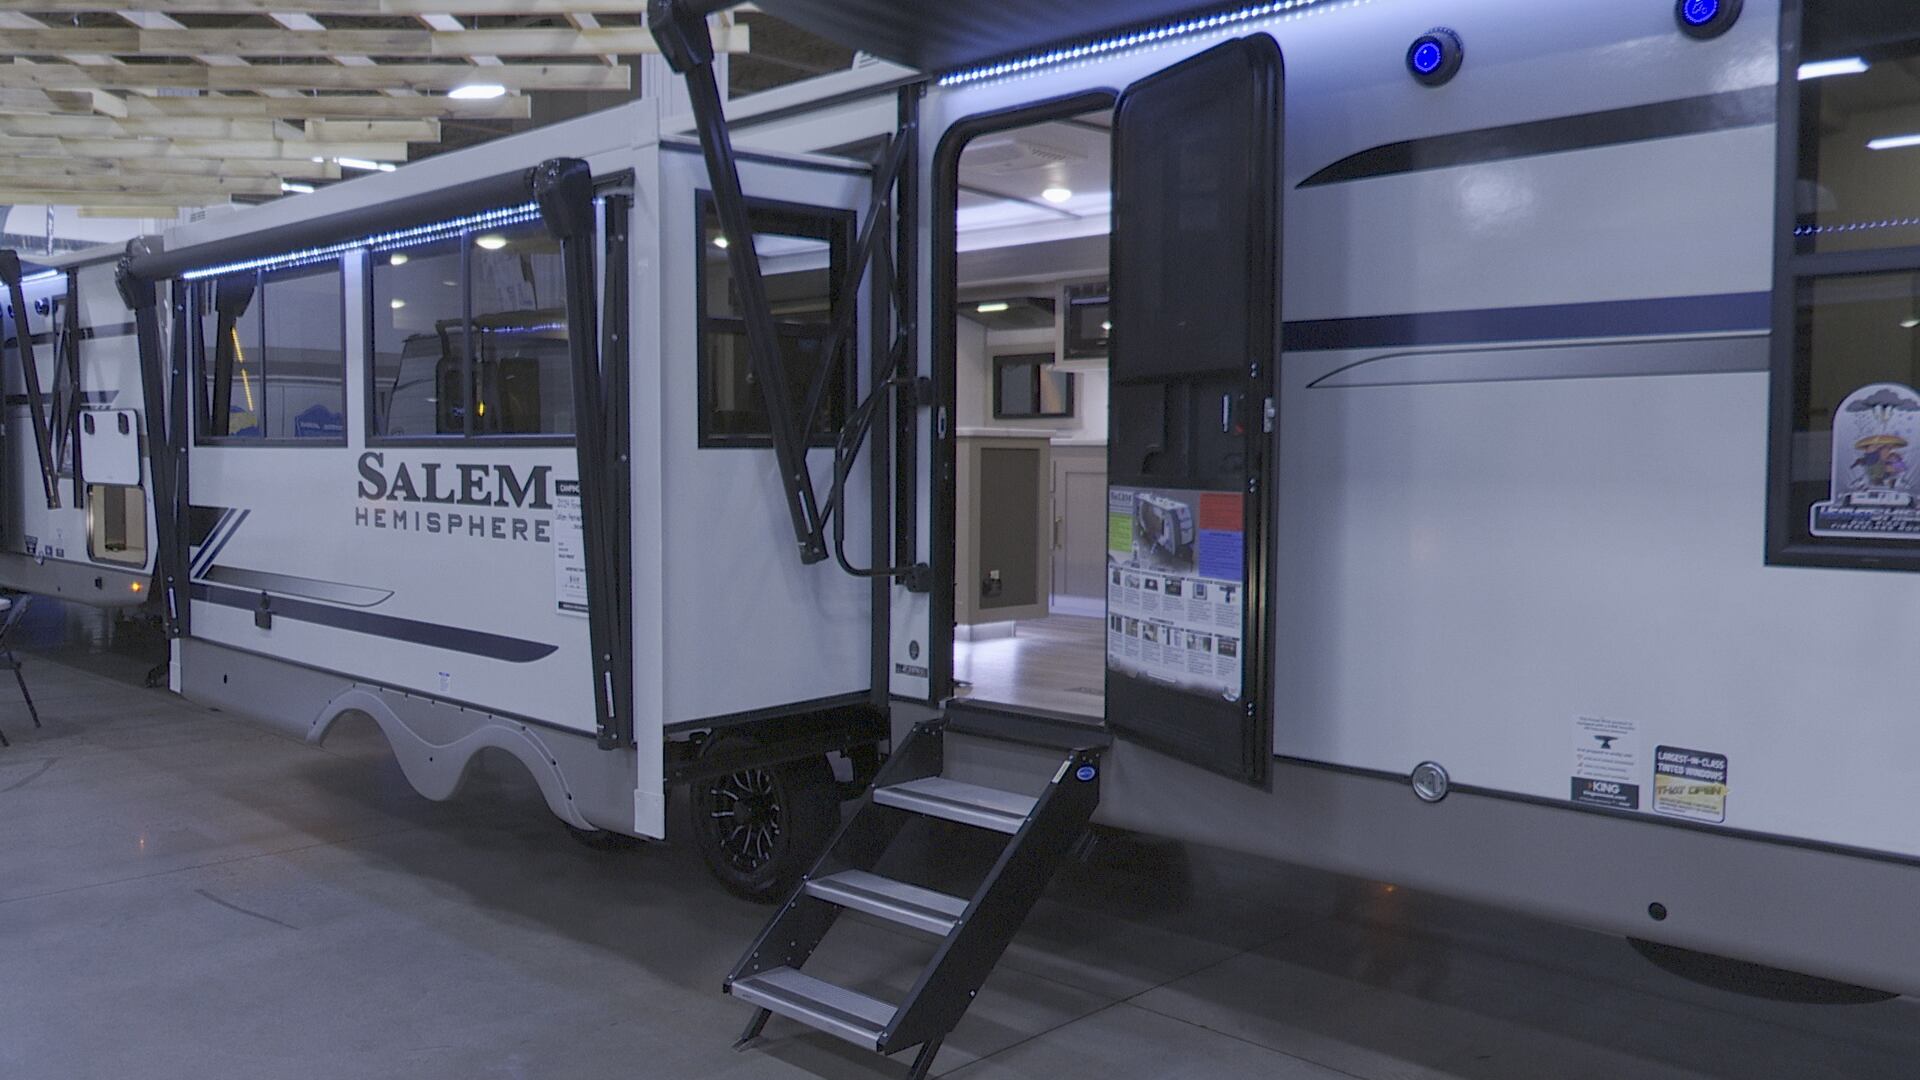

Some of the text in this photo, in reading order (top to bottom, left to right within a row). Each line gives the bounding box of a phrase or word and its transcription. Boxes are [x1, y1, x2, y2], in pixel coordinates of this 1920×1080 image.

[358, 452, 553, 509] SALEM
[355, 507, 551, 543] HEMISPHERE
[1592, 781, 1620, 795] KING
